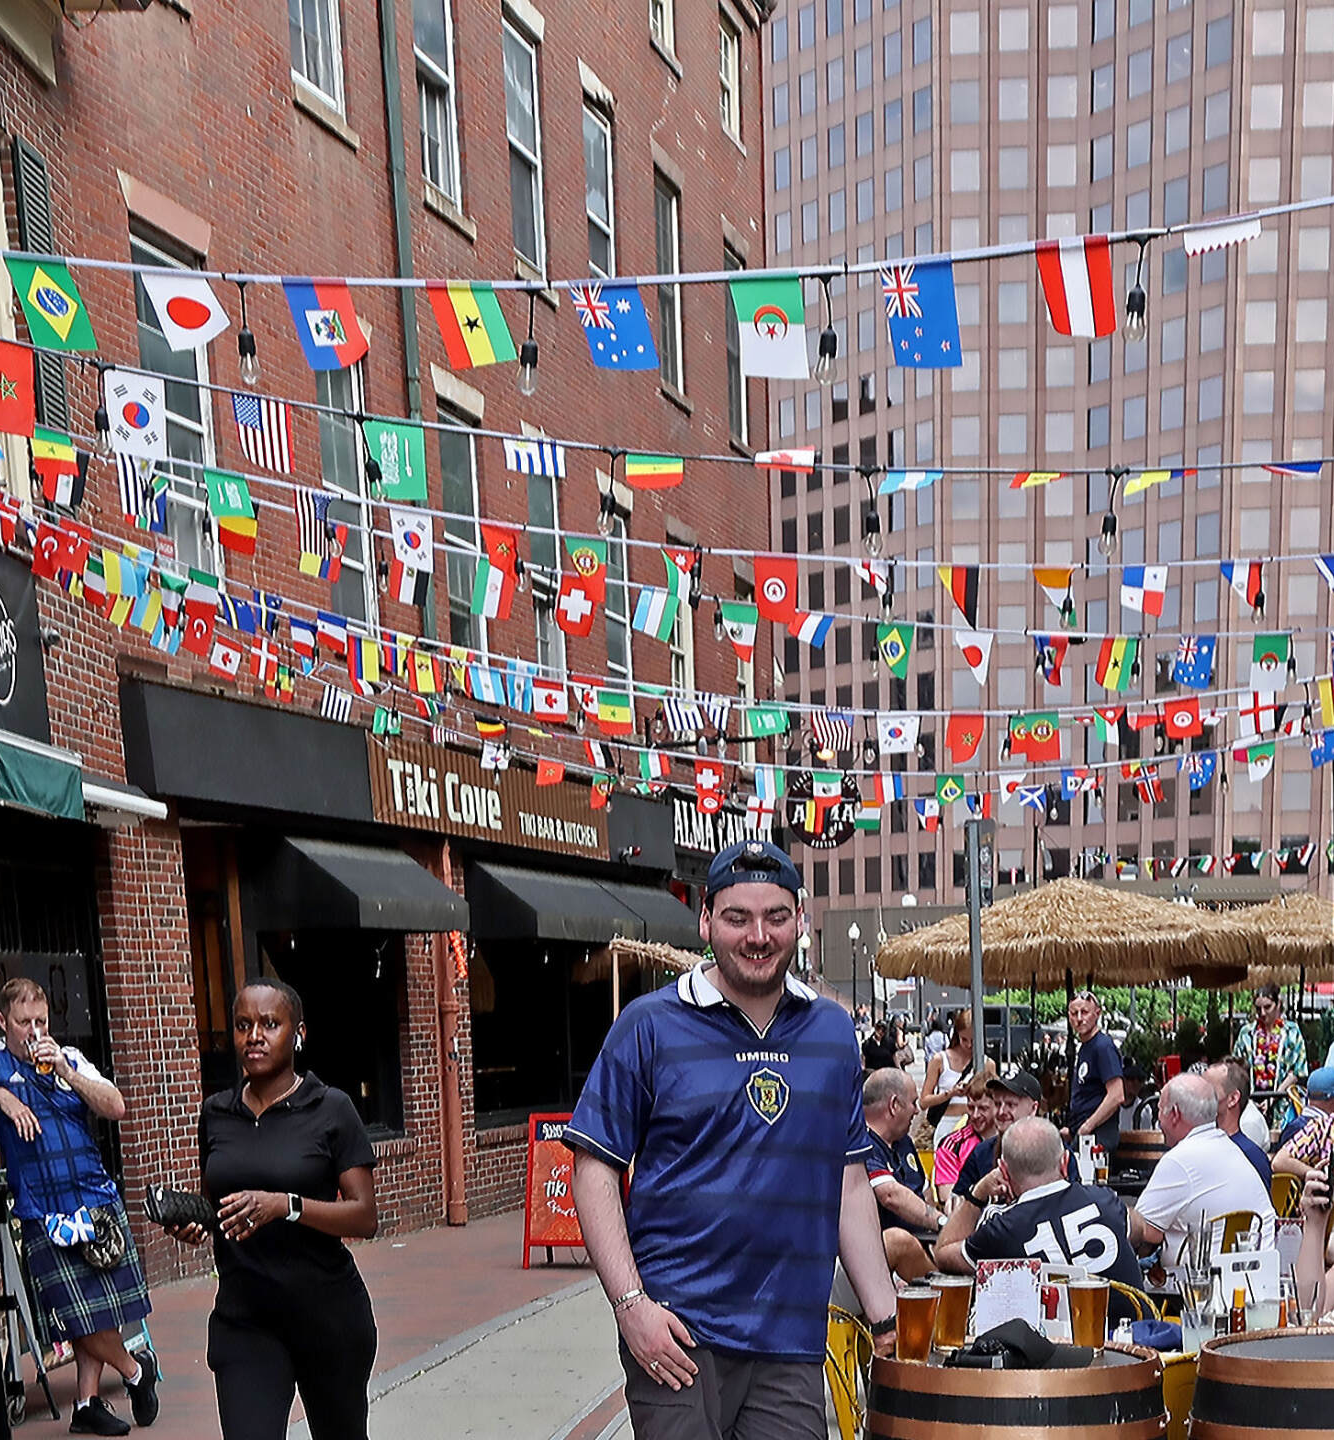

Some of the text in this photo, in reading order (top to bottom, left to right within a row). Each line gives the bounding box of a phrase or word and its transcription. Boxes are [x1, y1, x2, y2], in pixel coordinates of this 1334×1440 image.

[387, 759, 440, 819] Tiki
[444, 771, 503, 831] Cove
[537, 815, 556, 840] BAR
[556, 818, 564, 842] &
[673, 797, 716, 854] ALMA
[735, 1051, 790, 1062] UMBRO
[1023, 1202, 1119, 1273] 15
